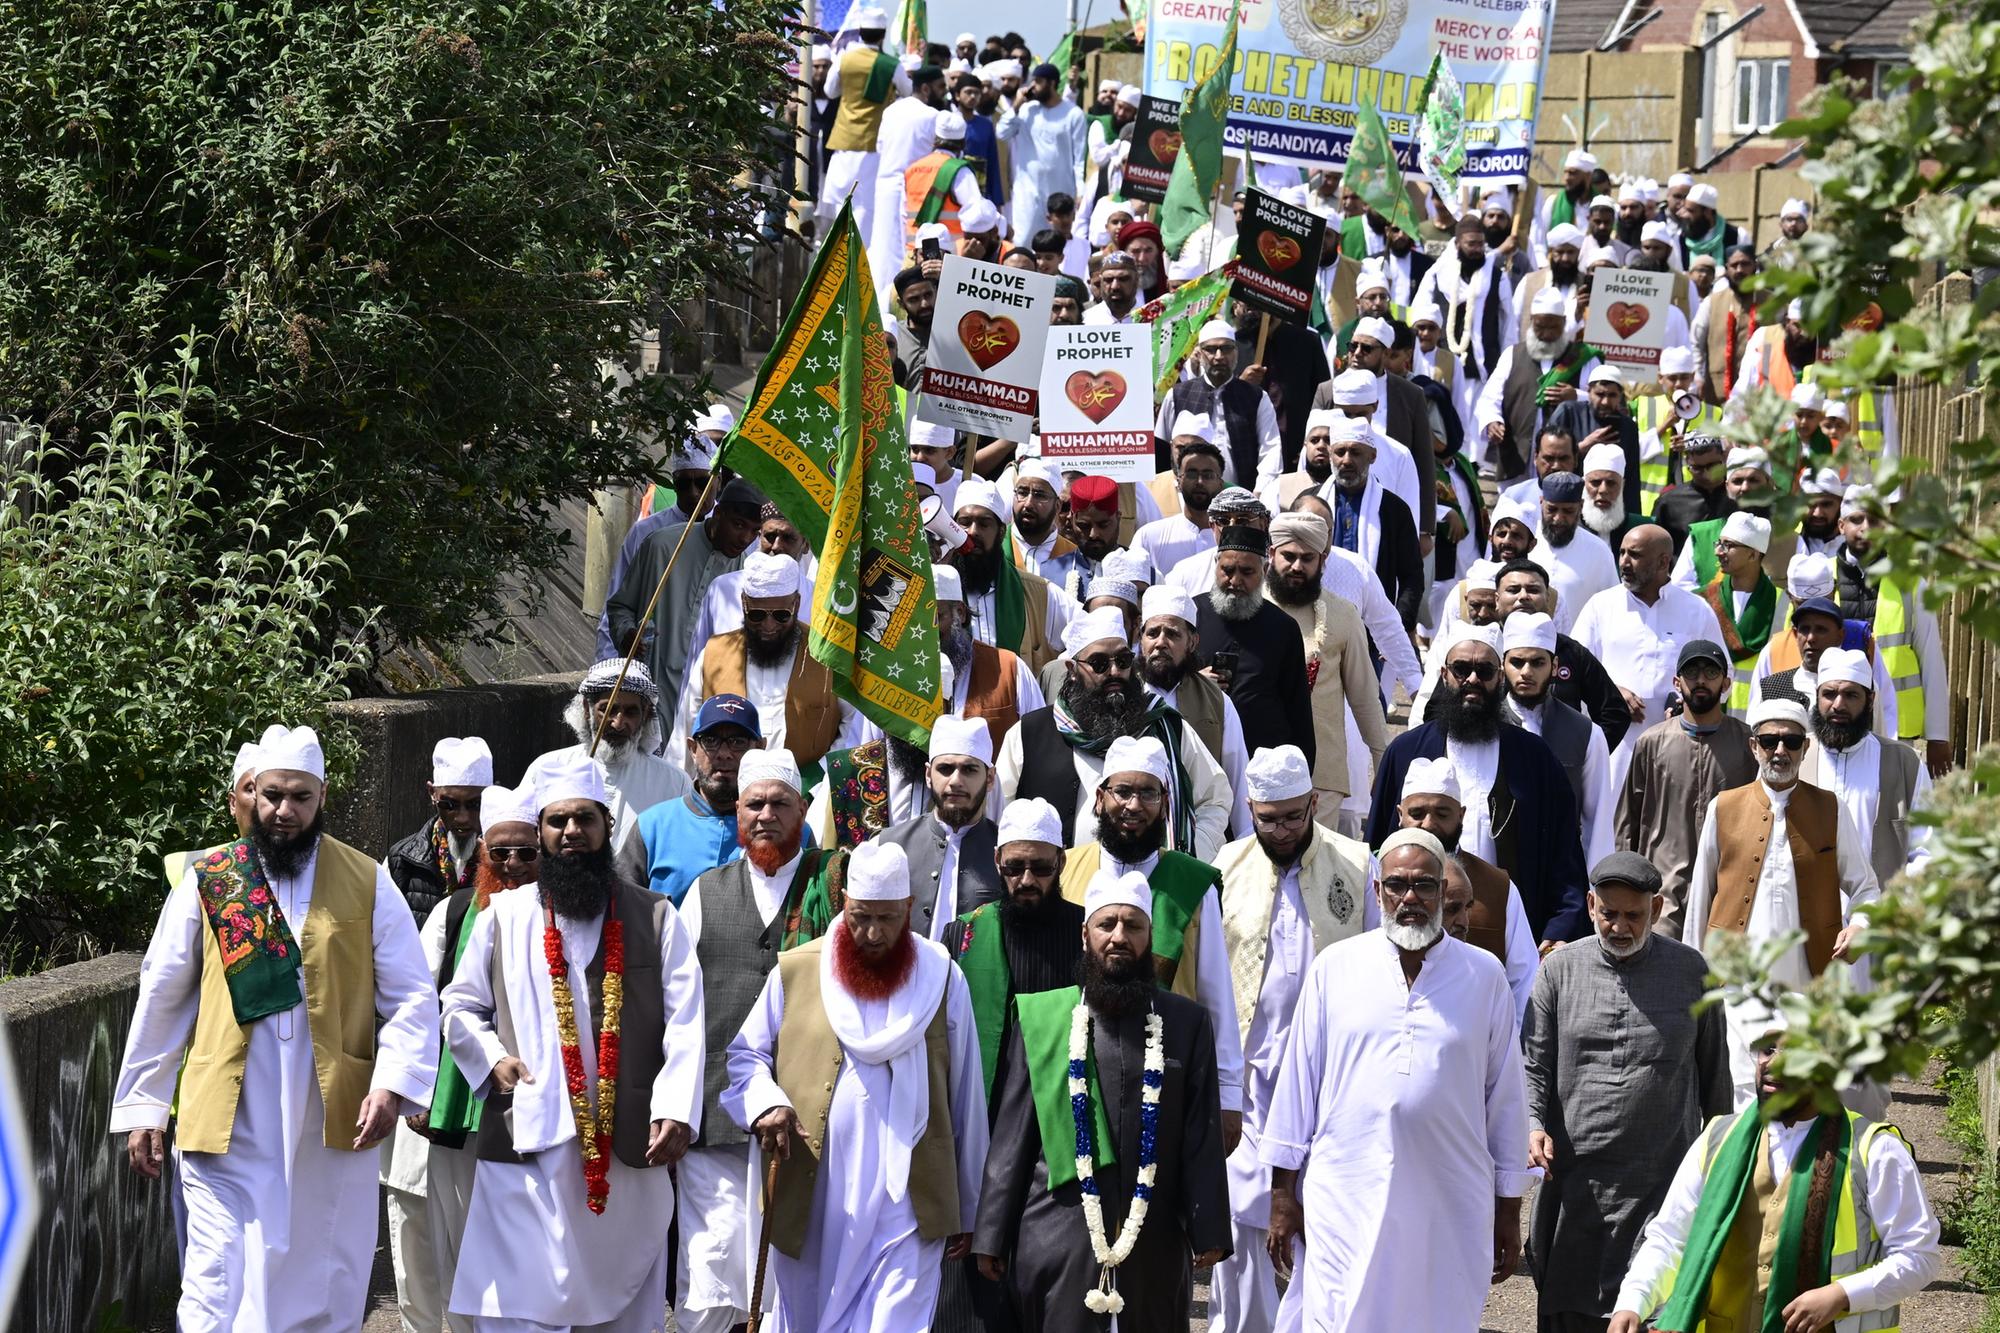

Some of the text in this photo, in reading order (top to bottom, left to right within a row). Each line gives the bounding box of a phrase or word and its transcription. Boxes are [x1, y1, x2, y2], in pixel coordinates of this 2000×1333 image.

[1435, 18, 1492, 40] MERCY
[1496, 27, 1513, 40] O
[1438, 40, 1468, 59] THE
[1321, 61, 1536, 122] MUHAMA
[1151, 100, 1170, 112] WE
[1148, 111, 1179, 124] PROP
[1247, 99, 1284, 118] AND
[1288, 104, 1360, 129] BLESSIN
[1387, 119, 1409, 135] BE
[1223, 126, 1329, 156] QSHBANDIYA
[1128, 166, 1171, 182] MUHAM
[1259, 196, 1313, 227] WE LOVE
[1255, 208, 1312, 237] PROPHET
[971, 268, 1026, 290] I LOVE
[1237, 265, 1308, 302] MUHAMMAD
[1620, 275, 1653, 285] LOVE
[956, 282, 1035, 309] PROPHET
[1605, 284, 1659, 297] PROPHET
[1068, 331, 1121, 344] I LOVE
[1057, 346, 1133, 360] PROPHET
[929, 371, 1030, 404] MUHAMMAD
[944, 402, 956, 411] ALL
[957, 406, 980, 415] OTHER
[980, 410, 1013, 422] PROPHETS
[997, 399, 1015, 409] UPON
[1047, 433, 1148, 448] MUHAMMAD
